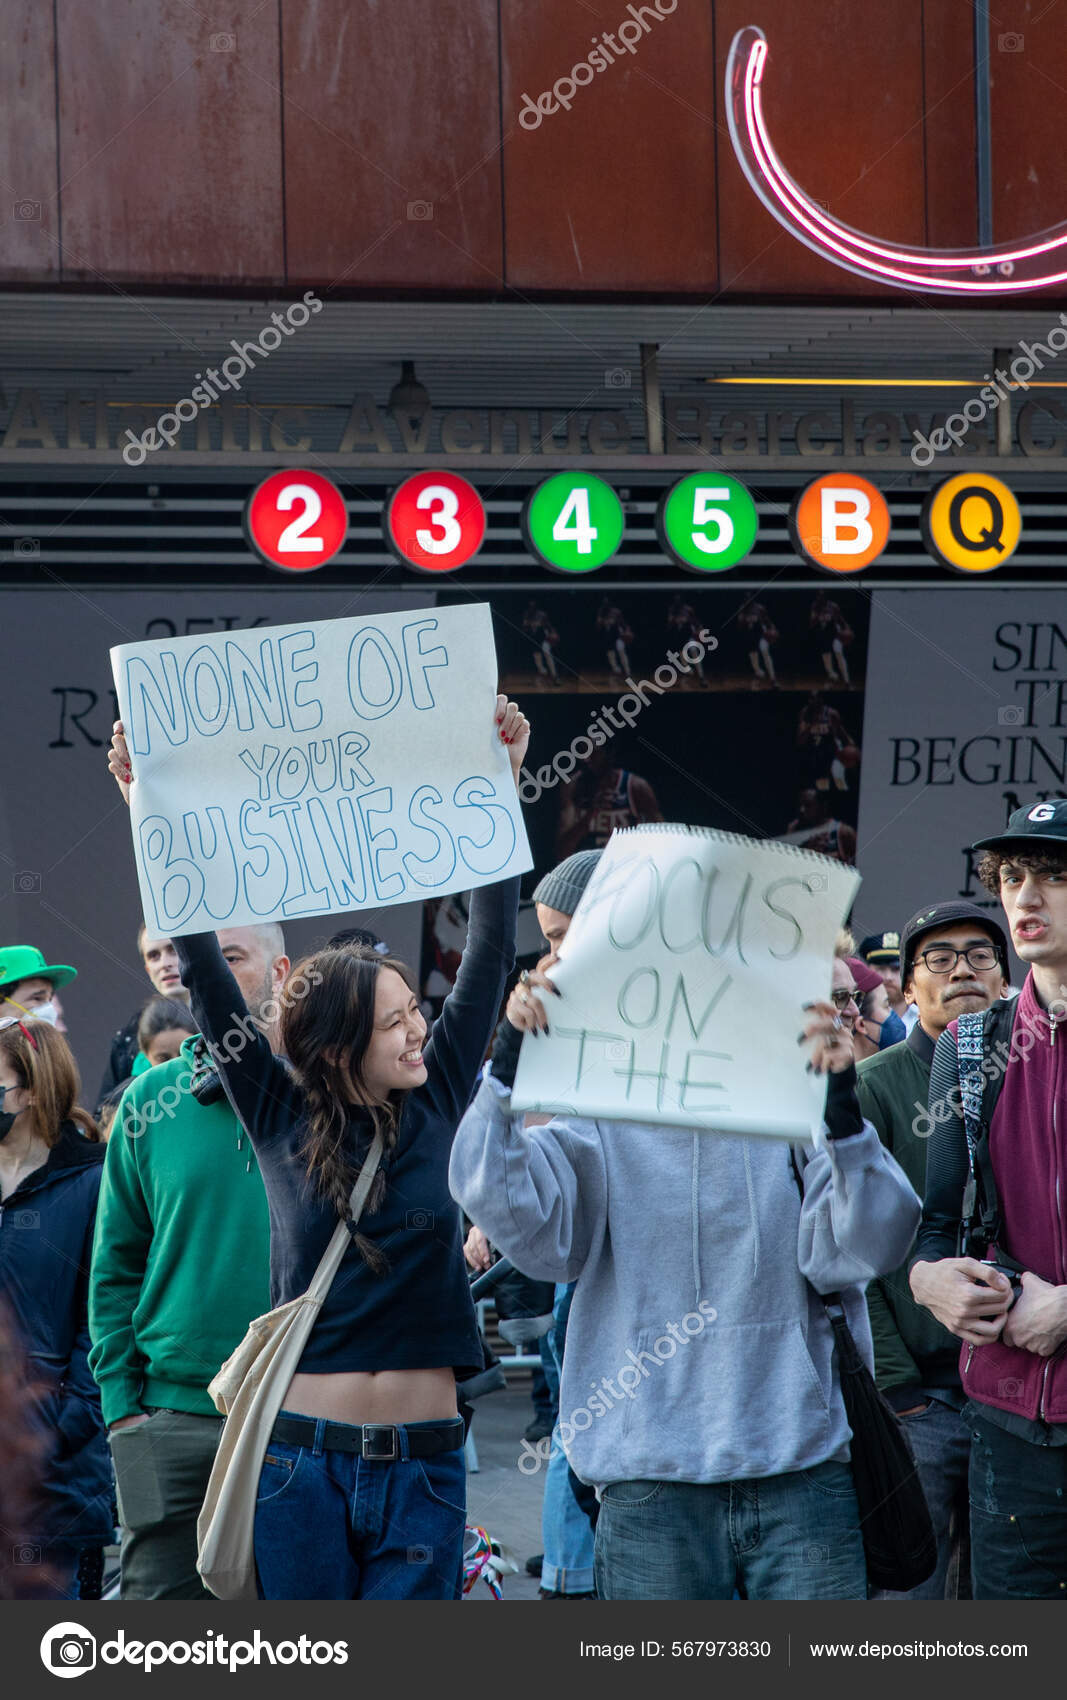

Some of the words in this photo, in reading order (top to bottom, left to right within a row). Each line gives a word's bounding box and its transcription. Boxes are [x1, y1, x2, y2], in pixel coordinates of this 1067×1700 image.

[339, 391, 633, 454] Avenue
[277, 485, 323, 552] 2
[416, 486, 461, 554] 3
[553, 488, 597, 554] 4
[691, 488, 733, 553] 5
[821, 488, 872, 554] B
[949, 486, 1006, 553] Q
[127, 630, 324, 755] NONE
[348, 619, 449, 721] OF
[239, 731, 374, 800] YOUR
[1028, 804, 1056, 822] G
[139, 776, 516, 932] BUSINESS
[581, 855, 815, 967] FOCUS
[617, 966, 734, 1041] ON
[555, 1025, 734, 1113] THE
